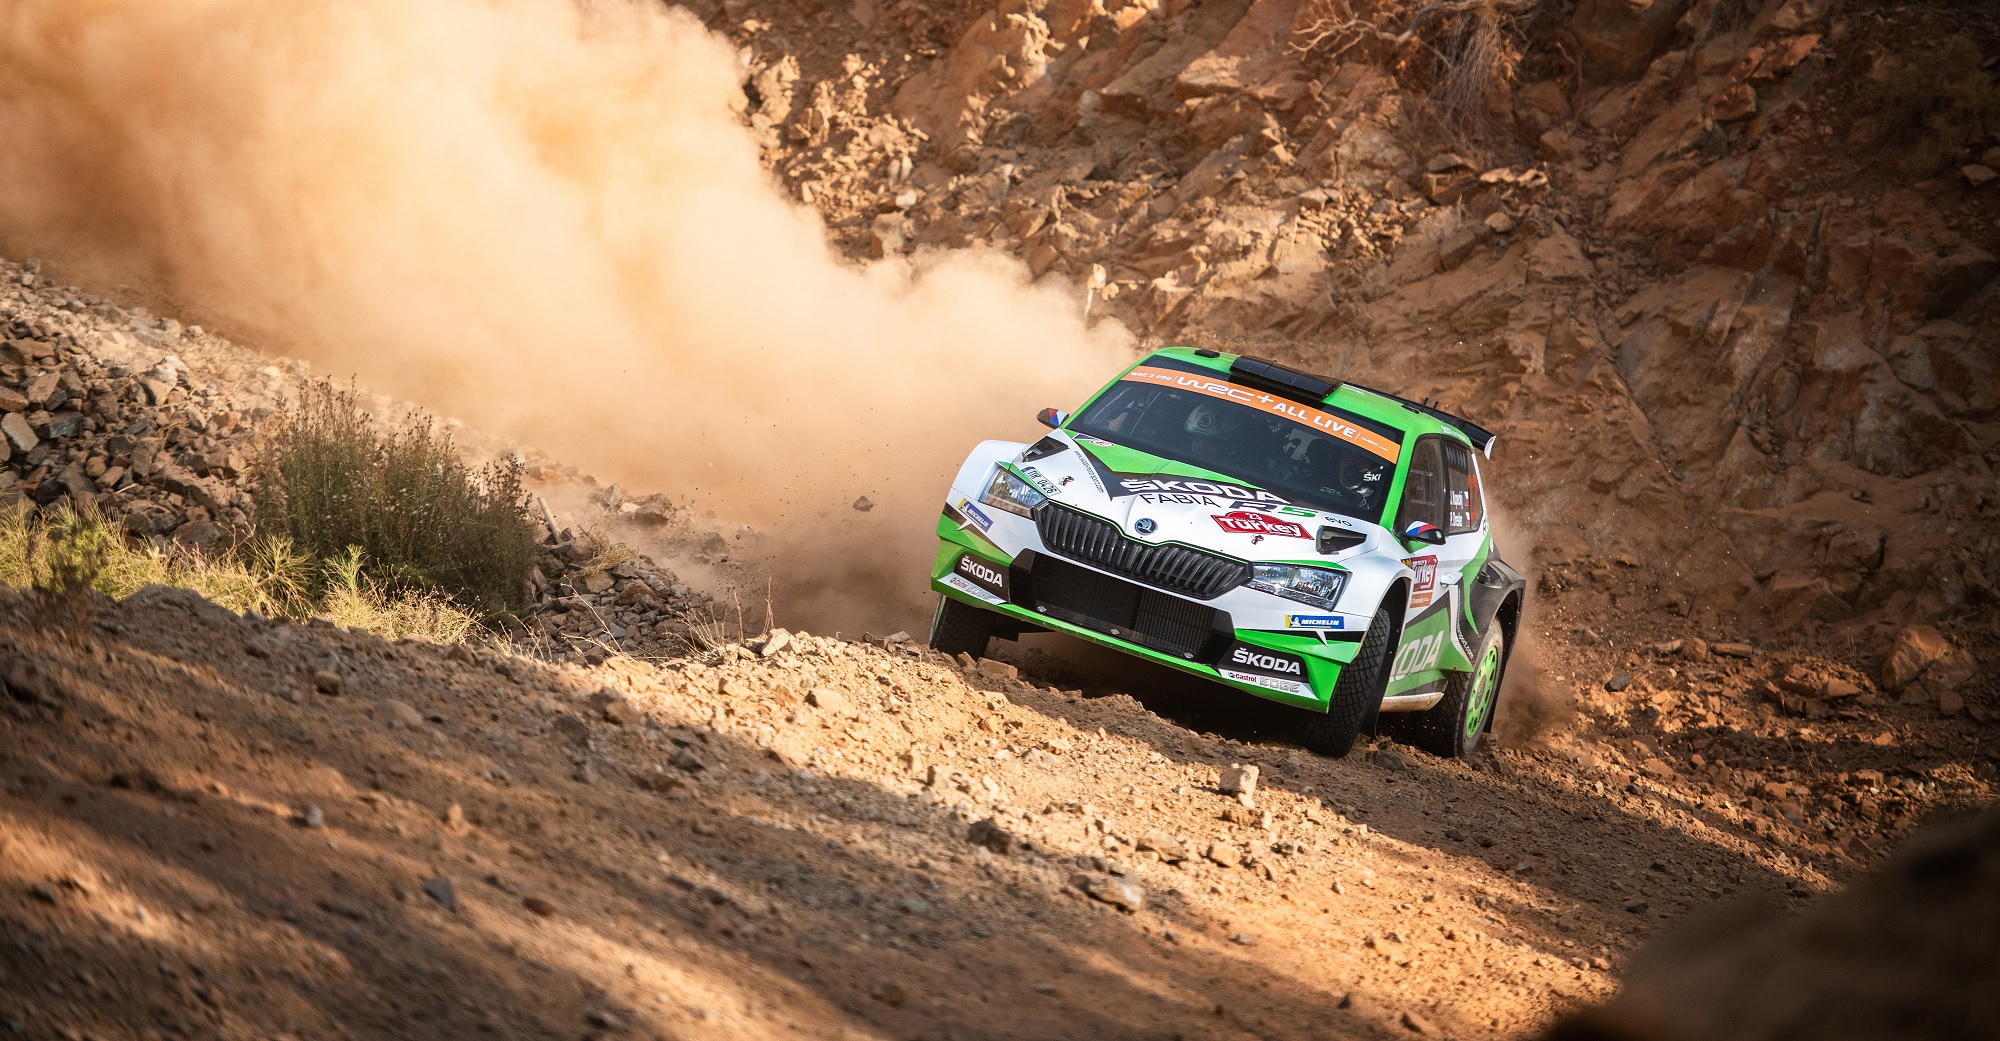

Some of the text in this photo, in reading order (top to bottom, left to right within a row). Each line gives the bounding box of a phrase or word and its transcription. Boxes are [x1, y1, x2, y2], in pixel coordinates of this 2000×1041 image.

[1272, 402, 1308, 421] ALL
[1313, 415, 1357, 438] LIVE
[1120, 478, 1291, 504] ŠKODA
[967, 507, 989, 528] MICHELIN
[1139, 494, 1319, 518] FABIA R5
[1325, 516, 1352, 527] evo
[960, 555, 1003, 588] ŠKODA
[1301, 618, 1340, 626] MICHELIN
[1232, 647, 1301, 675] ŠKODA
[1235, 673, 1300, 693] Castrol EDGE
